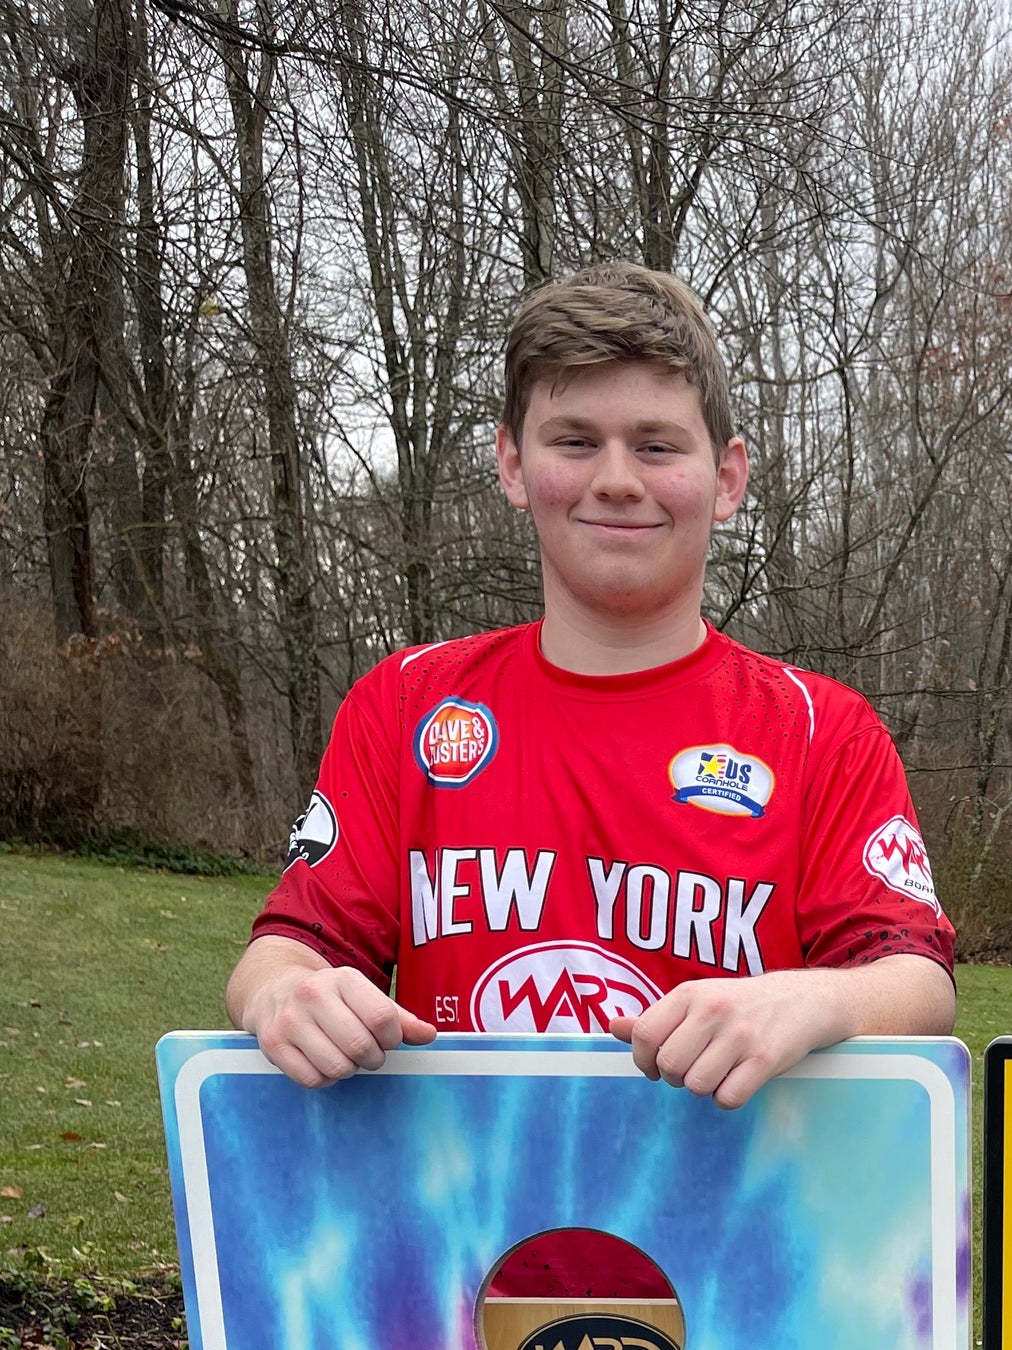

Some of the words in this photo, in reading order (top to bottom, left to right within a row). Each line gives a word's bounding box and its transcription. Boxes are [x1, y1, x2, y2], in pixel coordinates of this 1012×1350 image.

[724, 758, 752, 784] US
[695, 775, 749, 792] CORNHOLE
[701, 787, 742, 802] CERTIFIED
[408, 847, 556, 947] NEW
[585, 854, 776, 976] YORK
